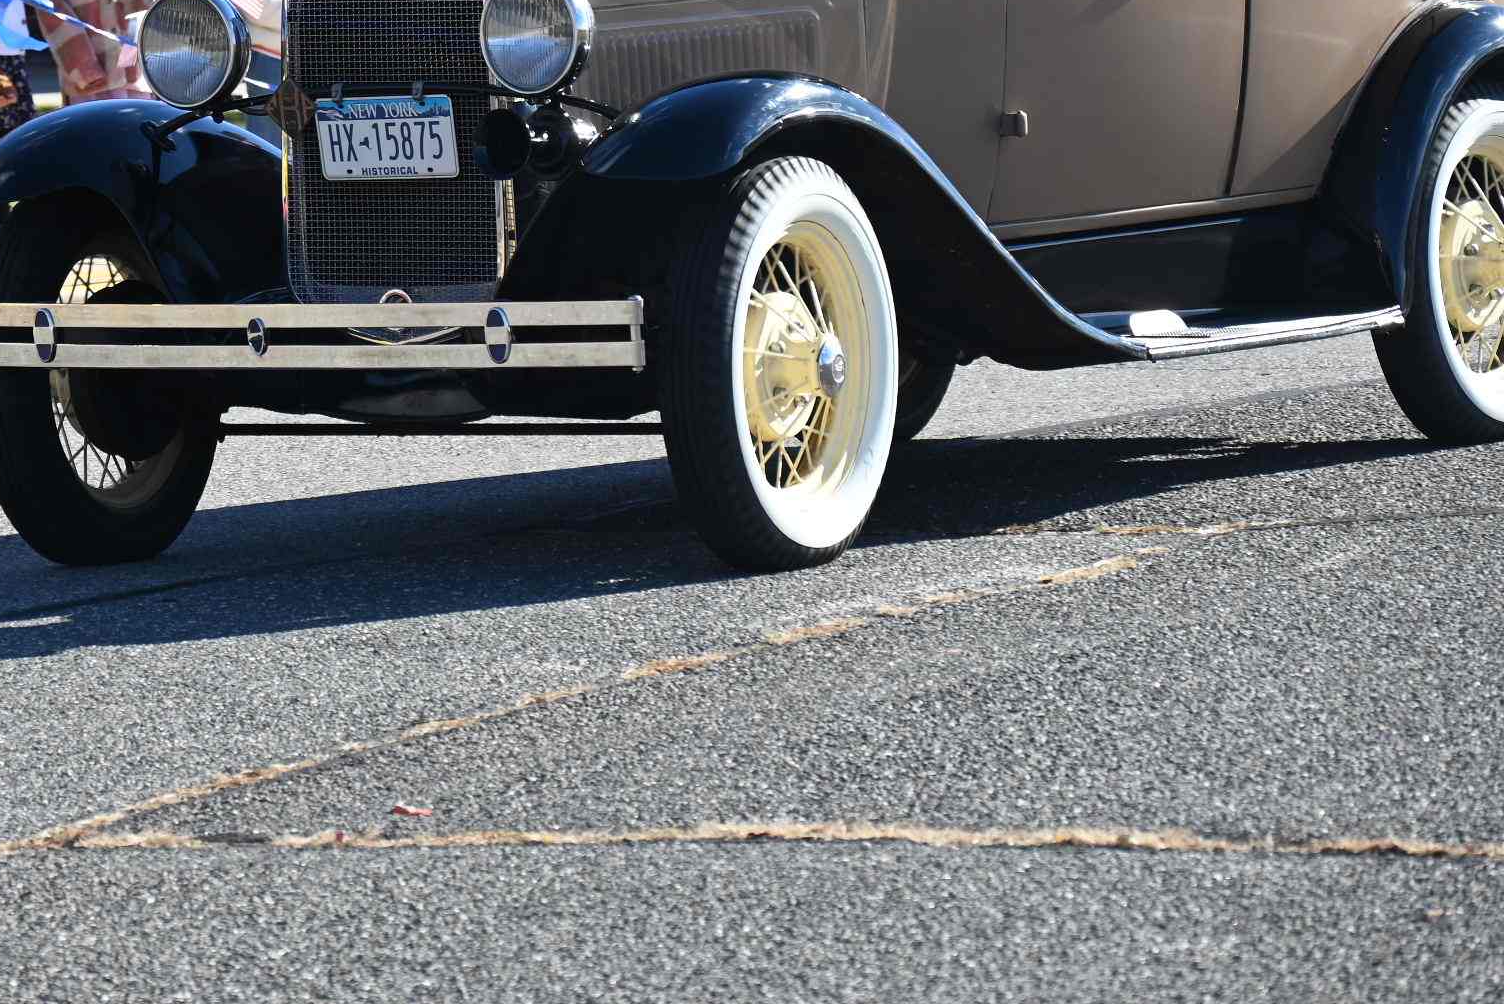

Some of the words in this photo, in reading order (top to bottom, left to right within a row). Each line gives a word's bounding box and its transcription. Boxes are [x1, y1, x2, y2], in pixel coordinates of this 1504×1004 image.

[347, 103, 378, 119] NEW
[381, 101, 419, 118] YORK
[372, 121, 443, 161] 15875
[362, 167, 418, 176] HISTORICAL
